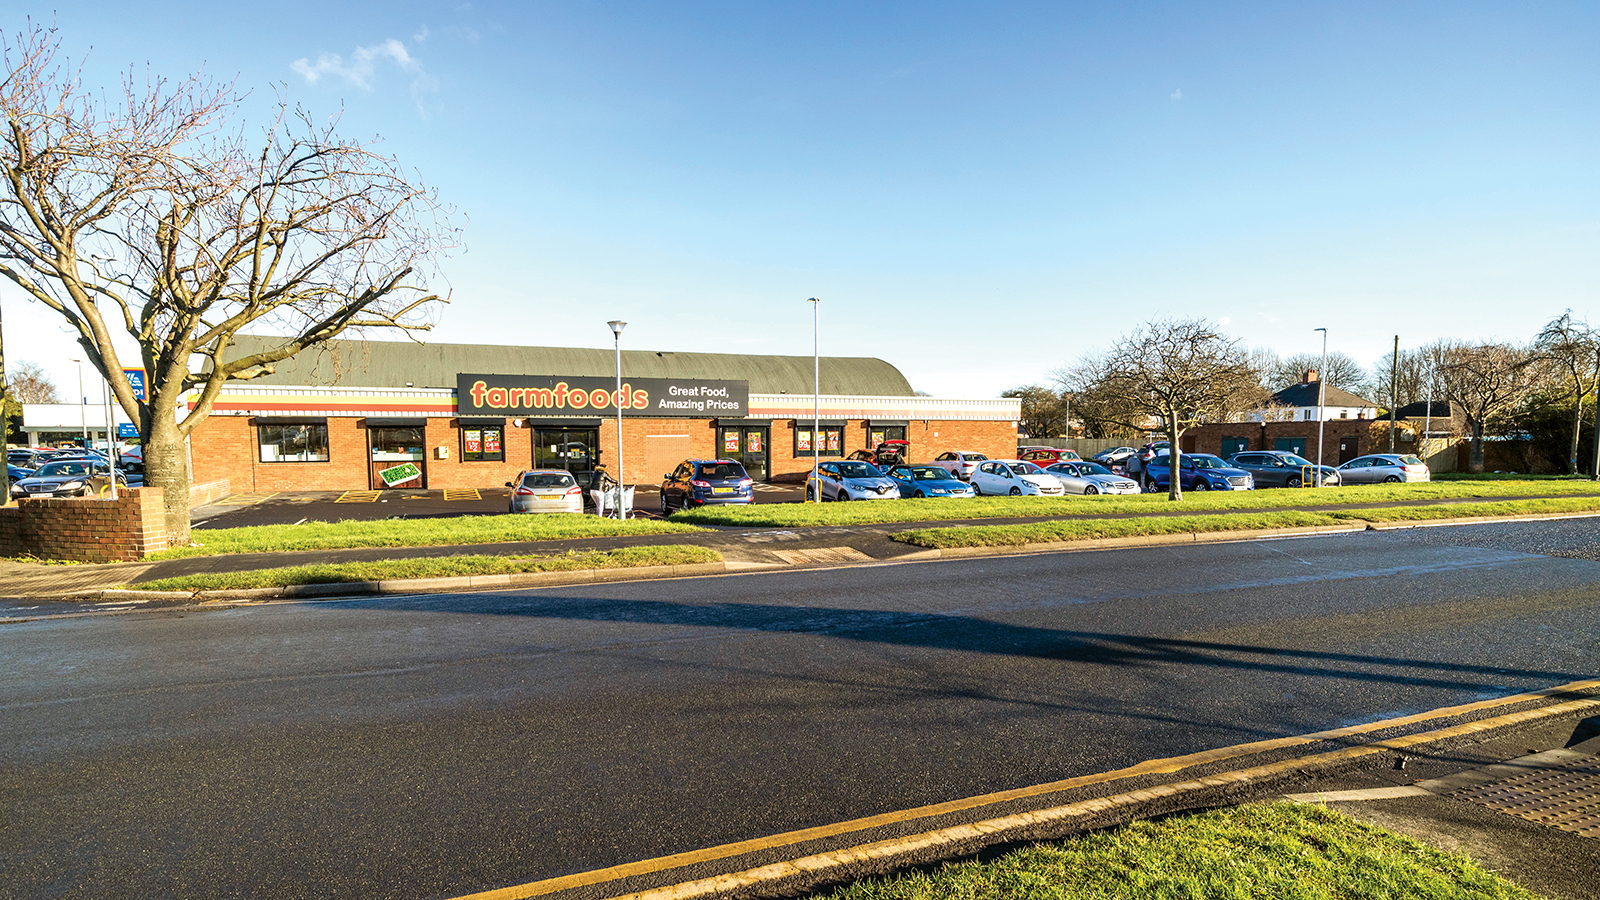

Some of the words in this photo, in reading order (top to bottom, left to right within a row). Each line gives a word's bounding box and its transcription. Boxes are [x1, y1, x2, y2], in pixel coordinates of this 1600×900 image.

[470, 380, 649, 409] farmfoods
[668, 385, 699, 396] Great
[700, 386, 730, 398] Food,
[658, 398, 704, 411] Amazing
[706, 399, 739, 410] Prices
